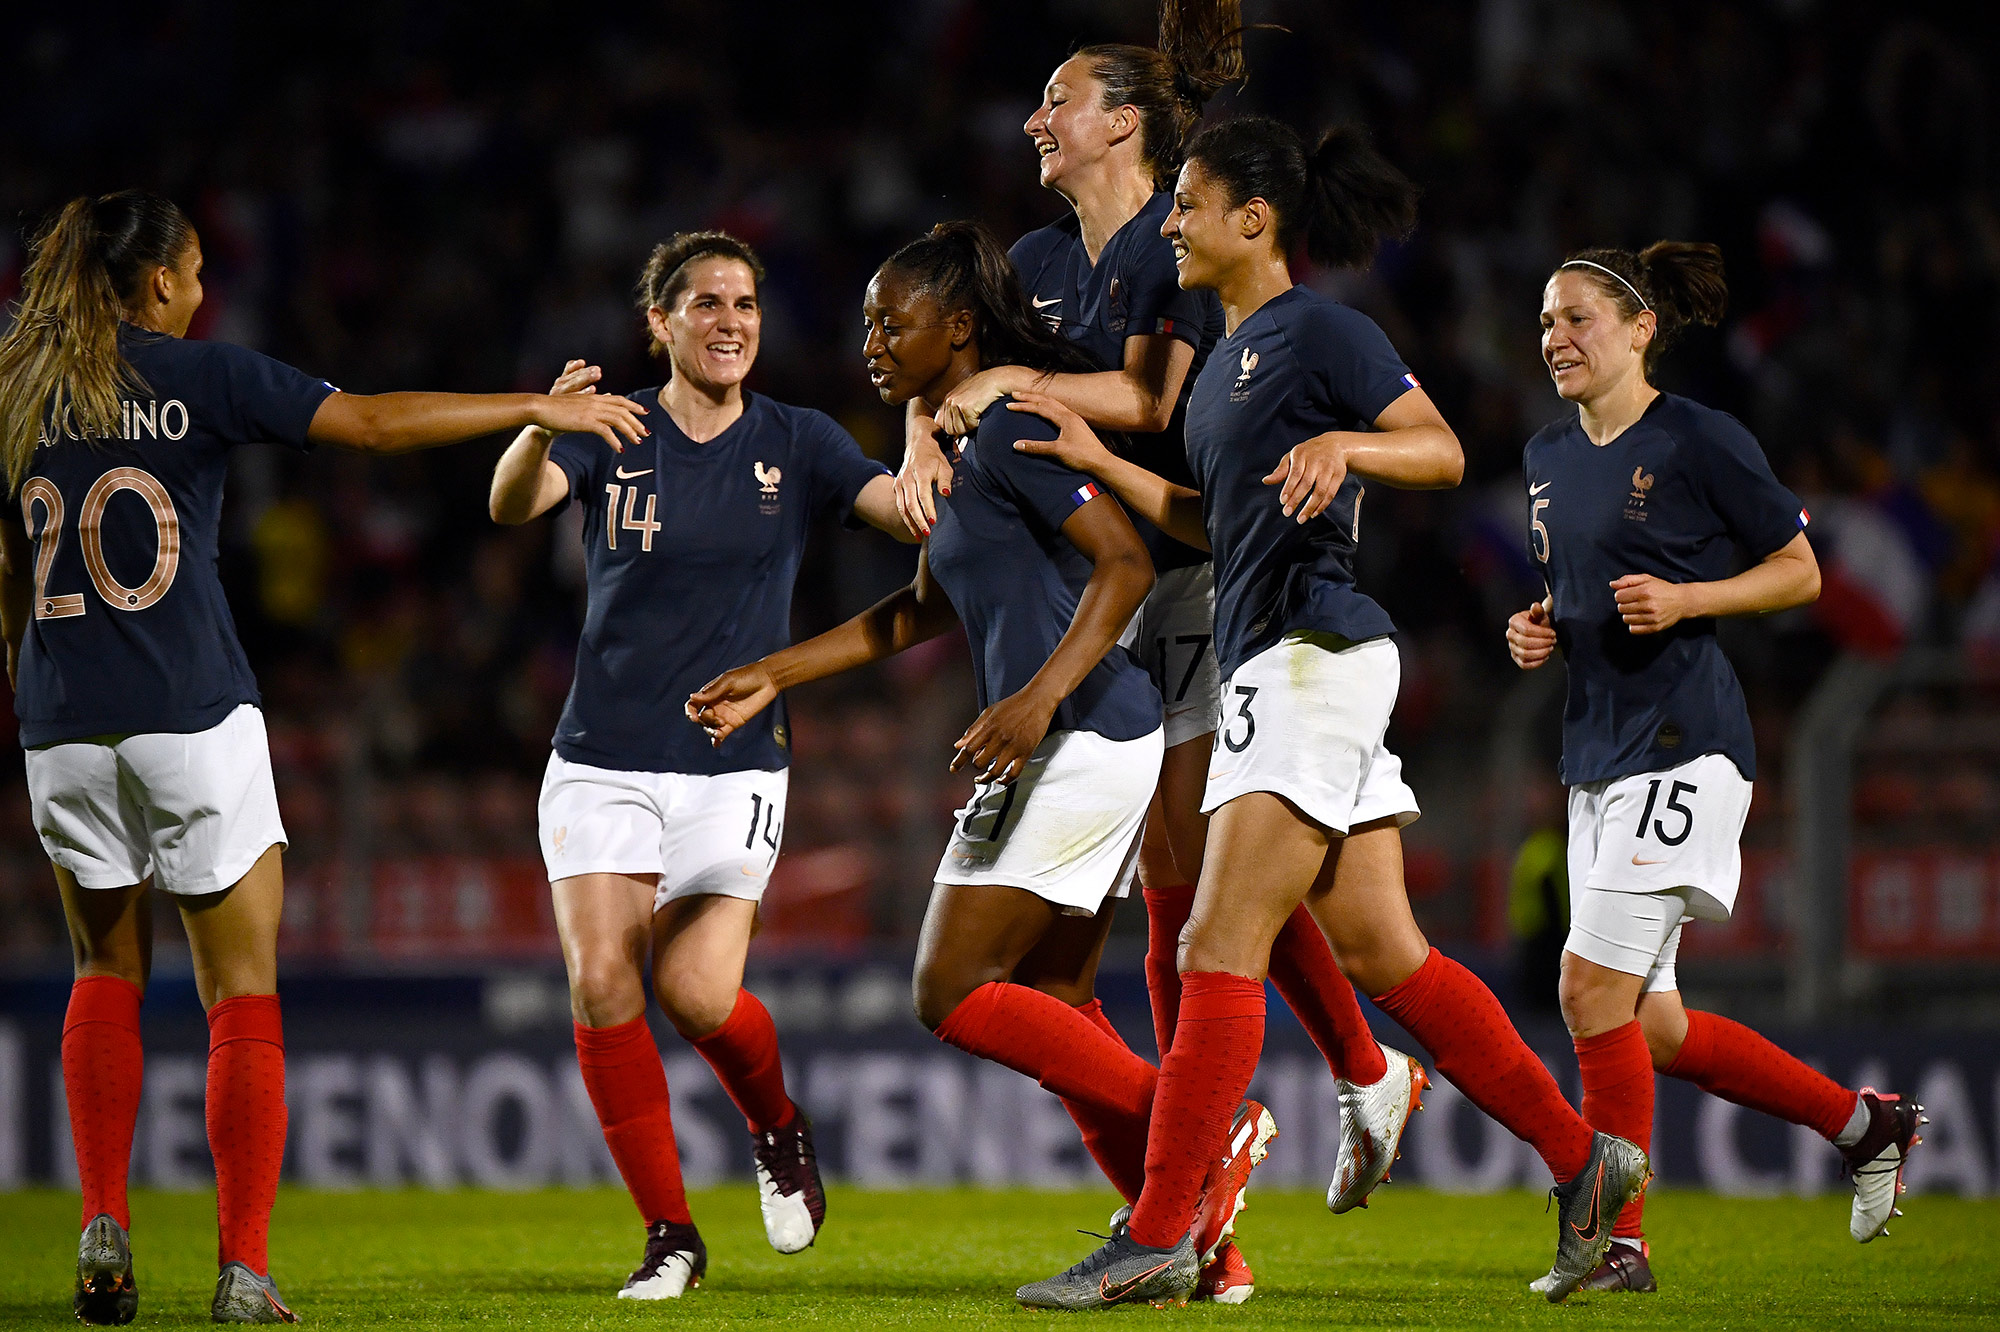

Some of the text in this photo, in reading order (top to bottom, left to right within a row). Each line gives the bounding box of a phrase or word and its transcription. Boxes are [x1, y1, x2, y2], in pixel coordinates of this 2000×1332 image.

[20, 466, 181, 620] 20
[605, 483, 662, 552] 14
[1156, 633, 1213, 705] 17
[745, 792, 781, 869] 14
[1635, 779, 1698, 846] 15
